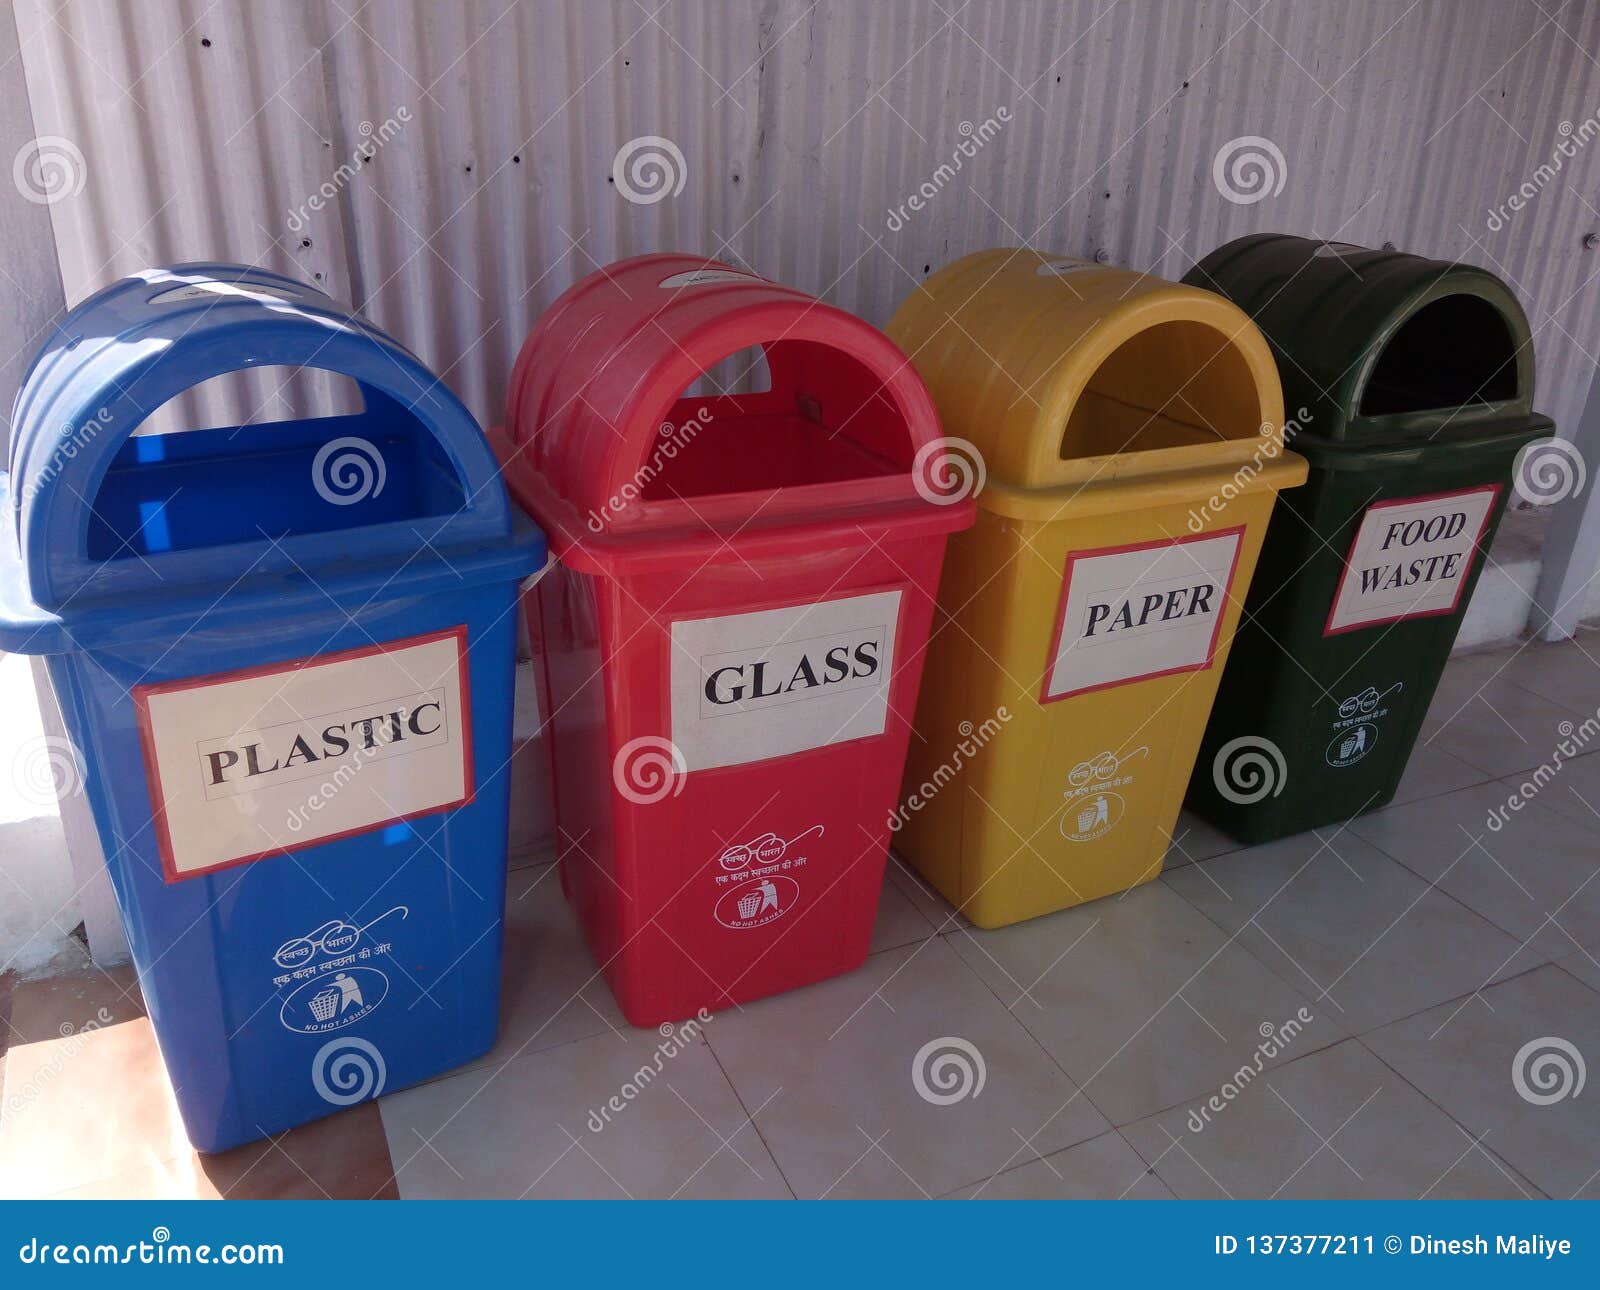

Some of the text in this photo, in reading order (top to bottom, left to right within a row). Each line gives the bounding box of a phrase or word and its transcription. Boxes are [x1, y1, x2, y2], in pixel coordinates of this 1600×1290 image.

[1380, 512, 1467, 551] FOOD
[1360, 553, 1463, 595] WASTE
[1082, 584, 1214, 637] PAPER
[705, 640, 878, 705] GLASS
[205, 700, 442, 786] PLASTIC
[326, 934, 353, 948] भारत
[272, 974, 291, 987] एक
[293, 965, 316, 980] कदम
[358, 947, 371, 960] की
[304, 1004, 373, 1031] NO HOT ASHES
